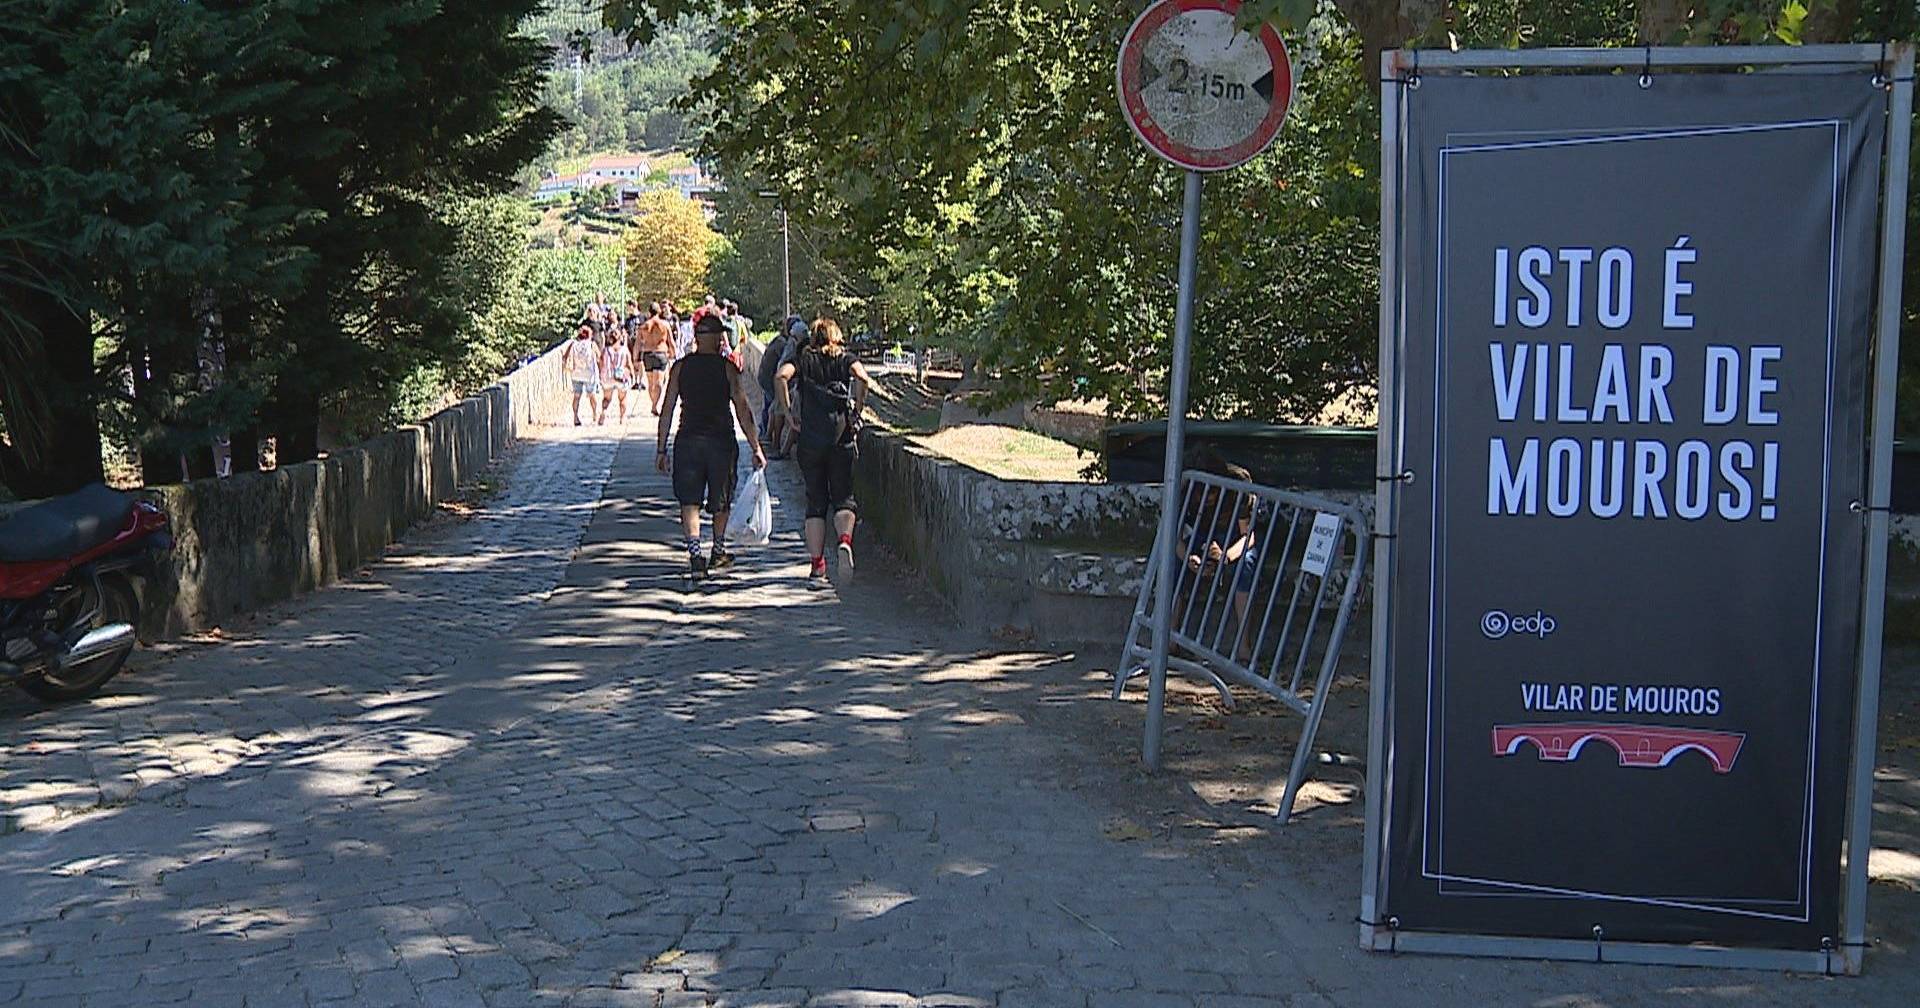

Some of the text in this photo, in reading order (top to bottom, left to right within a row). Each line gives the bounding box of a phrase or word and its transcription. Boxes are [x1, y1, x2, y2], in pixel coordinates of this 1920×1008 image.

[1493, 236, 1697, 328] ISTO É
[1489, 344, 1782, 425] VILAR DE
[1487, 437, 1780, 520] MOUROS!
[1511, 611, 1555, 637] edp
[1521, 683, 1721, 714] VILAR DE MOUROS
